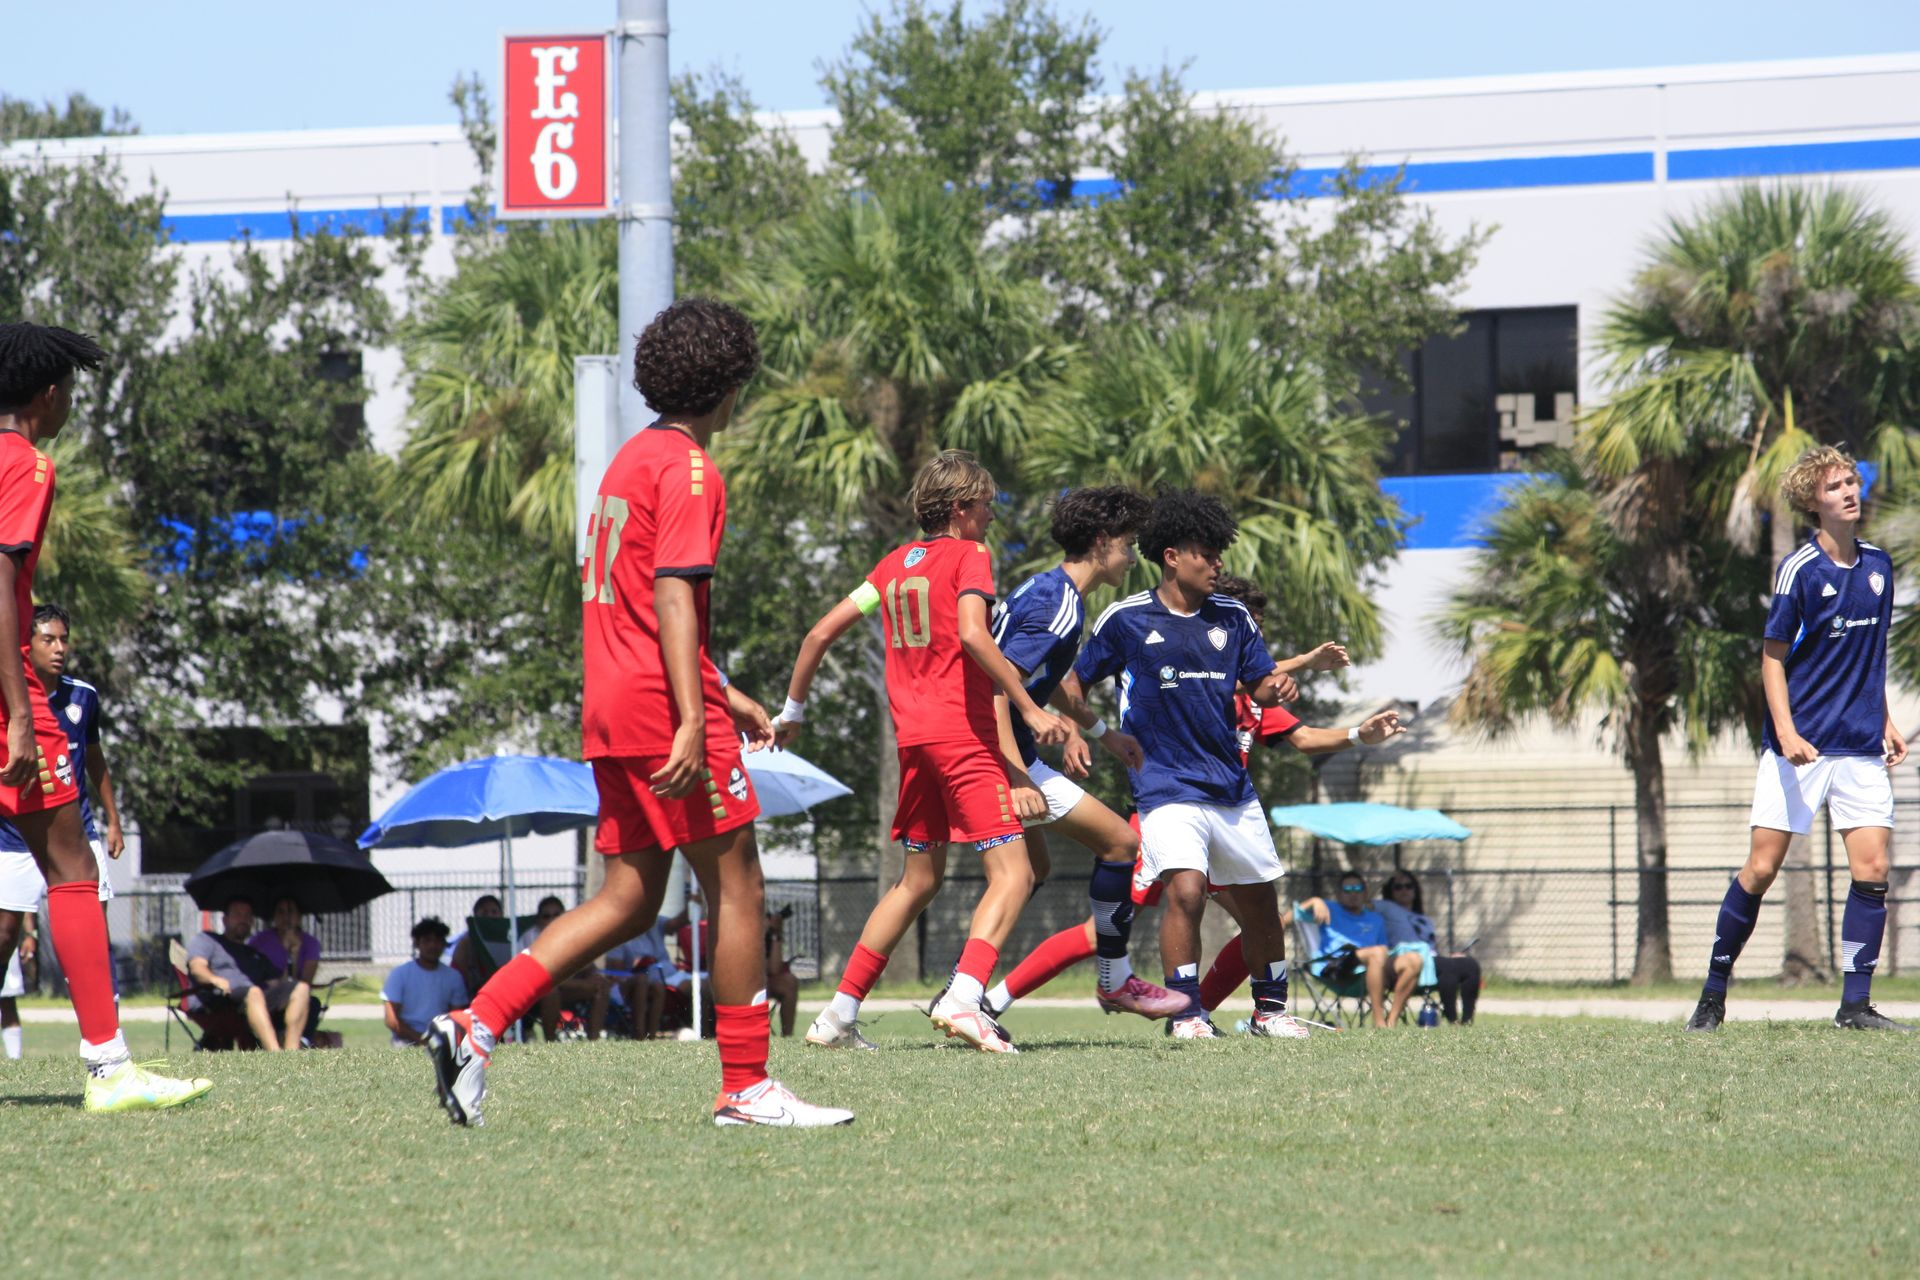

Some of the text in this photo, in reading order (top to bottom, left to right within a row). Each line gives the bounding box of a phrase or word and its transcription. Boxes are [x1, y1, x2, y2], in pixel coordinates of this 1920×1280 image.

[530, 46, 580, 119] E
[530, 122, 578, 200] 6
[886, 576, 931, 649] 10
[1210, 671, 1227, 680] BMW
